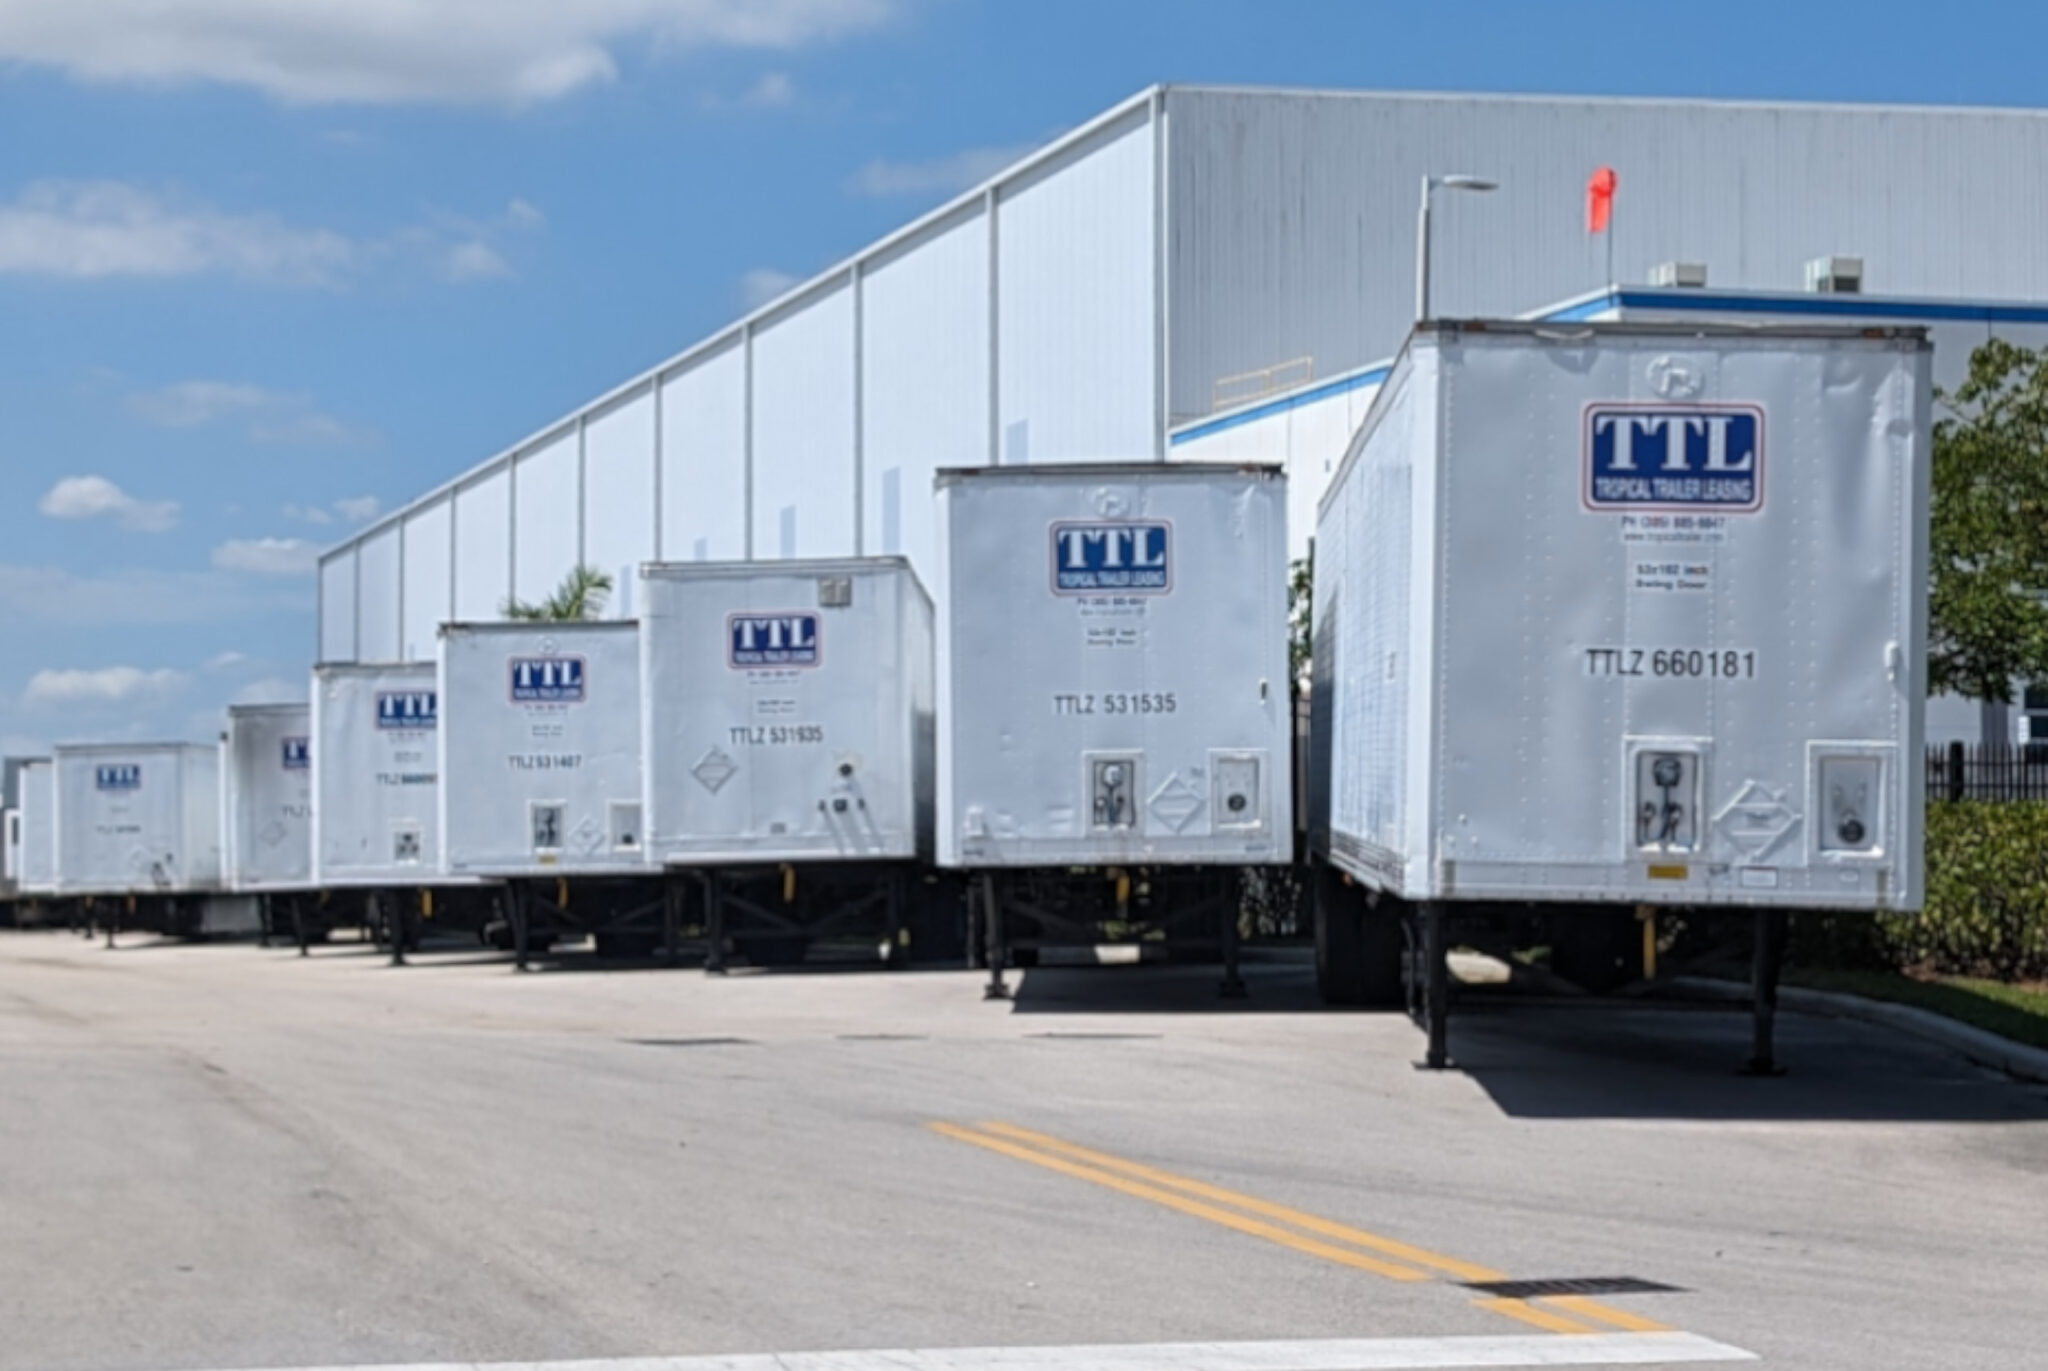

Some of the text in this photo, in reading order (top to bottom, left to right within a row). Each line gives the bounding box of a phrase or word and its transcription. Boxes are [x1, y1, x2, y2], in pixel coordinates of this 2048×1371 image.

[1595, 415, 1753, 470] TTL
[1594, 478, 1752, 500] TROPICAL TRAILER LEASING
[1059, 529, 1164, 568] TTL
[733, 618, 815, 648] TTL
[513, 661, 581, 686] TTL
[1586, 649, 1755, 677] TTLZ 660181
[1054, 693, 1176, 714] TTLZ 531535
[729, 727, 765, 745] TTLZ
